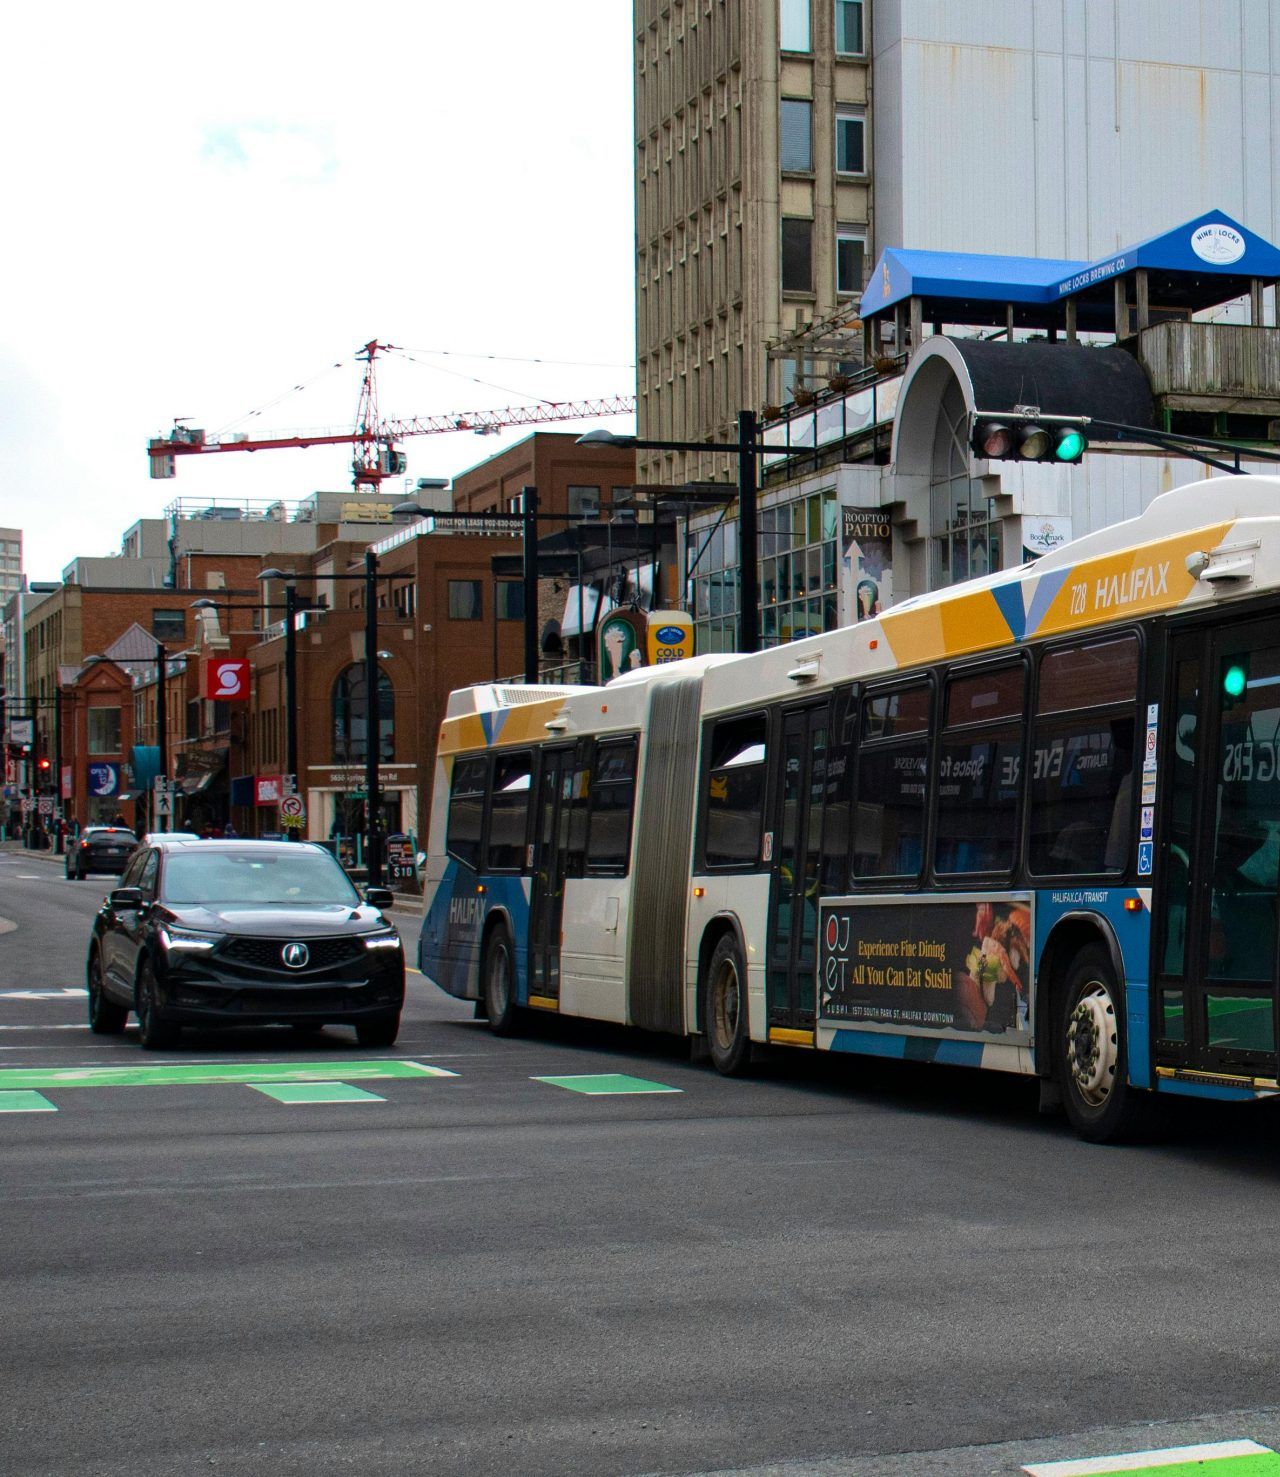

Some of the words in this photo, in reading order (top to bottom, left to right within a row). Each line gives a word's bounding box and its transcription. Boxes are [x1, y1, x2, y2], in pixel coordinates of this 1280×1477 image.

[1196, 229, 1213, 241] NINE
[1218, 229, 1240, 244] LOCKS
[1059, 280, 1072, 295] NINE
[1072, 273, 1090, 289] LOCKS
[1090, 262, 1115, 282] BREWING
[454, 518, 465, 527] FOR
[467, 518, 483, 527] LEASE
[845, 512, 890, 523] ROOFTOP
[845, 523, 890, 537] PATIO
[1070, 581, 1087, 616] 728
[1094, 561, 1171, 610] HALIFAX
[656, 648, 685, 658] COLD
[450, 897, 487, 924] HALIFAX
[858, 939, 899, 960] Experience
[900, 939, 917, 957] Fine
[919, 940, 946, 962] Dining
[852, 965, 865, 985] All
[867, 966, 884, 986] You
[886, 966, 905, 987] Can
[907, 967, 922, 988] Eat
[924, 968, 953, 990] Sushi
[863, 1007, 880, 1016] SOUTH
[880, 1008, 893, 1018] PARK
[901, 1010, 922, 1020] HALIFAX
[923, 1011, 954, 1023] DOWNTOWN
